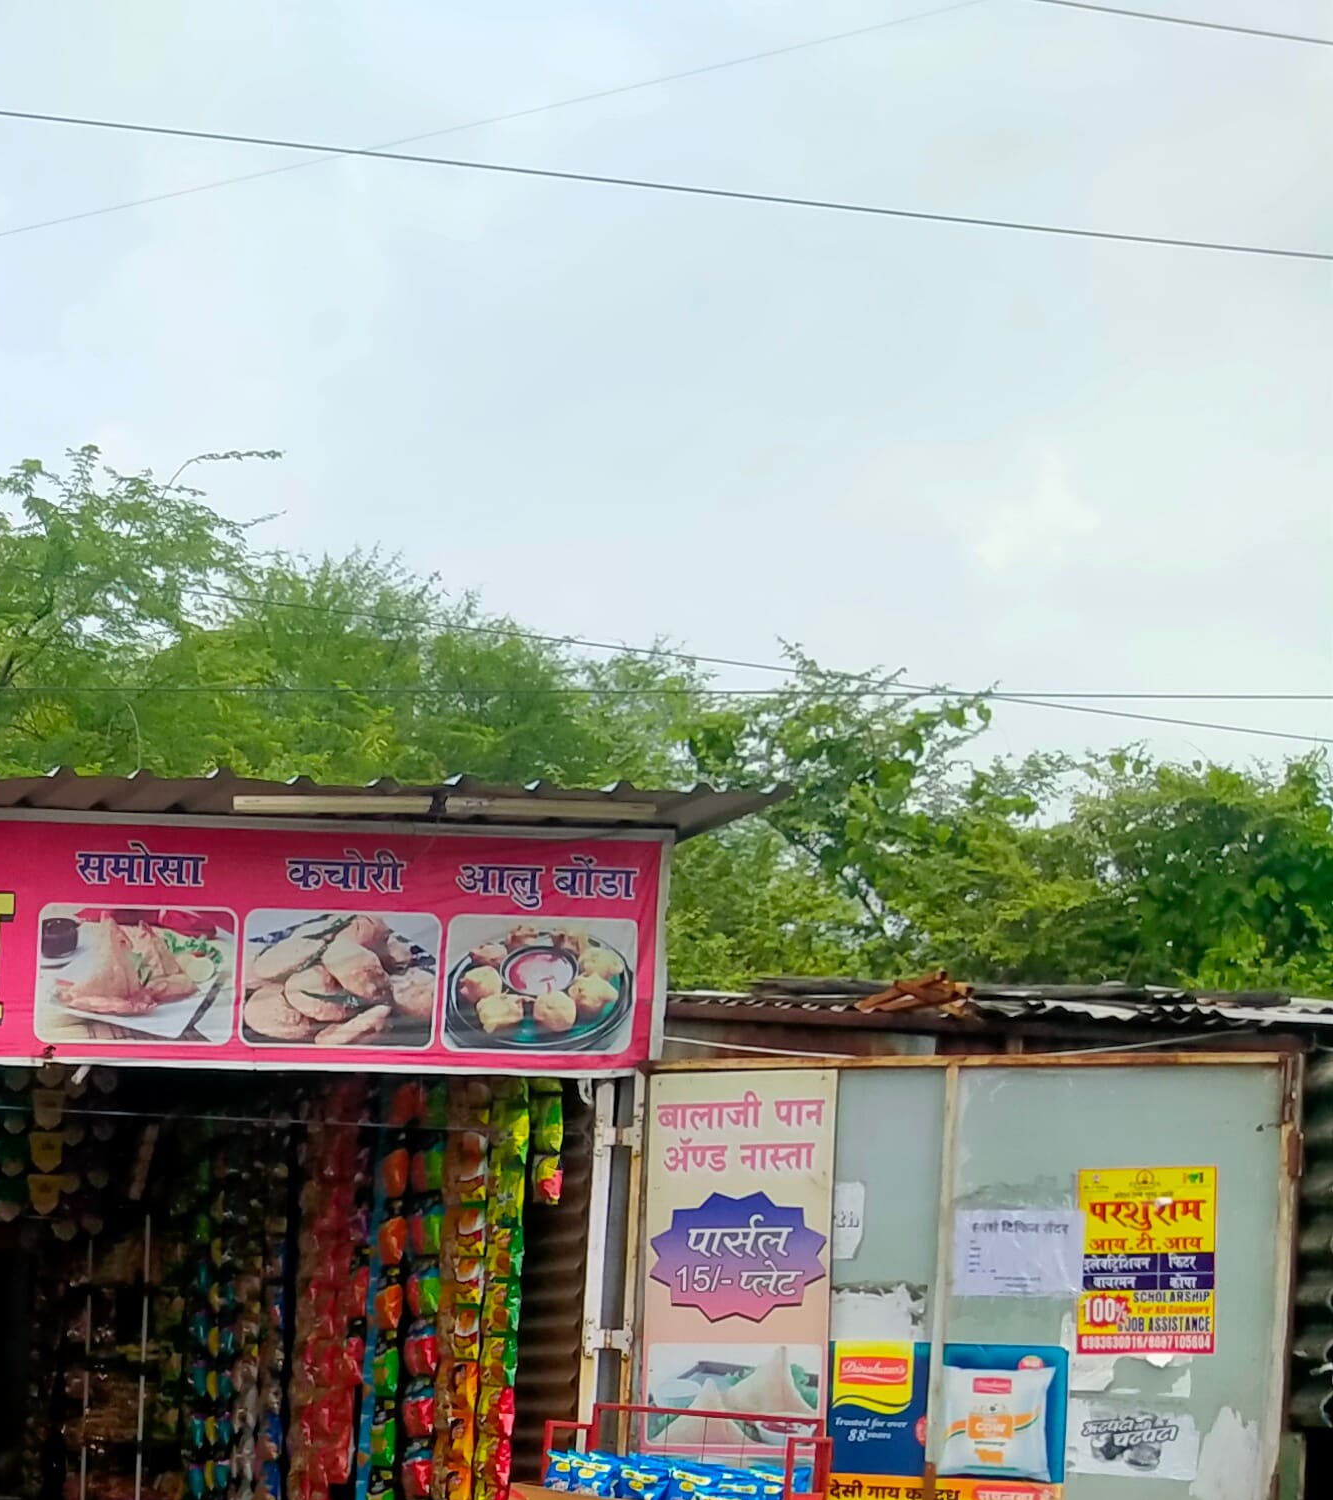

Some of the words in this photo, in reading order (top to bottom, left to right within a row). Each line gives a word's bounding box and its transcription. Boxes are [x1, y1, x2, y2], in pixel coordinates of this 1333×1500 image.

[75, 840, 207, 887] समोसा
[285, 848, 407, 894] कचोरी
[455, 861, 544, 909] आलु
[552, 855, 640, 900] बोंडा
[657, 1090, 762, 1130] बालाजी
[774, 1098, 826, 1127] पान
[740, 1141, 816, 1171] नास्ता
[1088, 1199, 1207, 1232] परशुराम
[686, 1214, 794, 1259] पार्सल
[675, 1264, 733, 1295] 15/-
[738, 1260, 804, 1298] प्लेट
[1083, 1296, 1126, 1324] 100%
[1133, 1290, 1211, 1304] SCHOLARSHIP
[1124, 1317, 1145, 1332] JOB
[1148, 1316, 1211, 1332] ASSISTANCE
[835, 1416, 870, 1427] Trusted
[870, 1417, 885, 1430] for
[886, 1420, 909, 1429] over
[847, 1428, 867, 1442] 88
[830, 1480, 862, 1500] देसी
[867, 1485, 900, 1500] गाय
